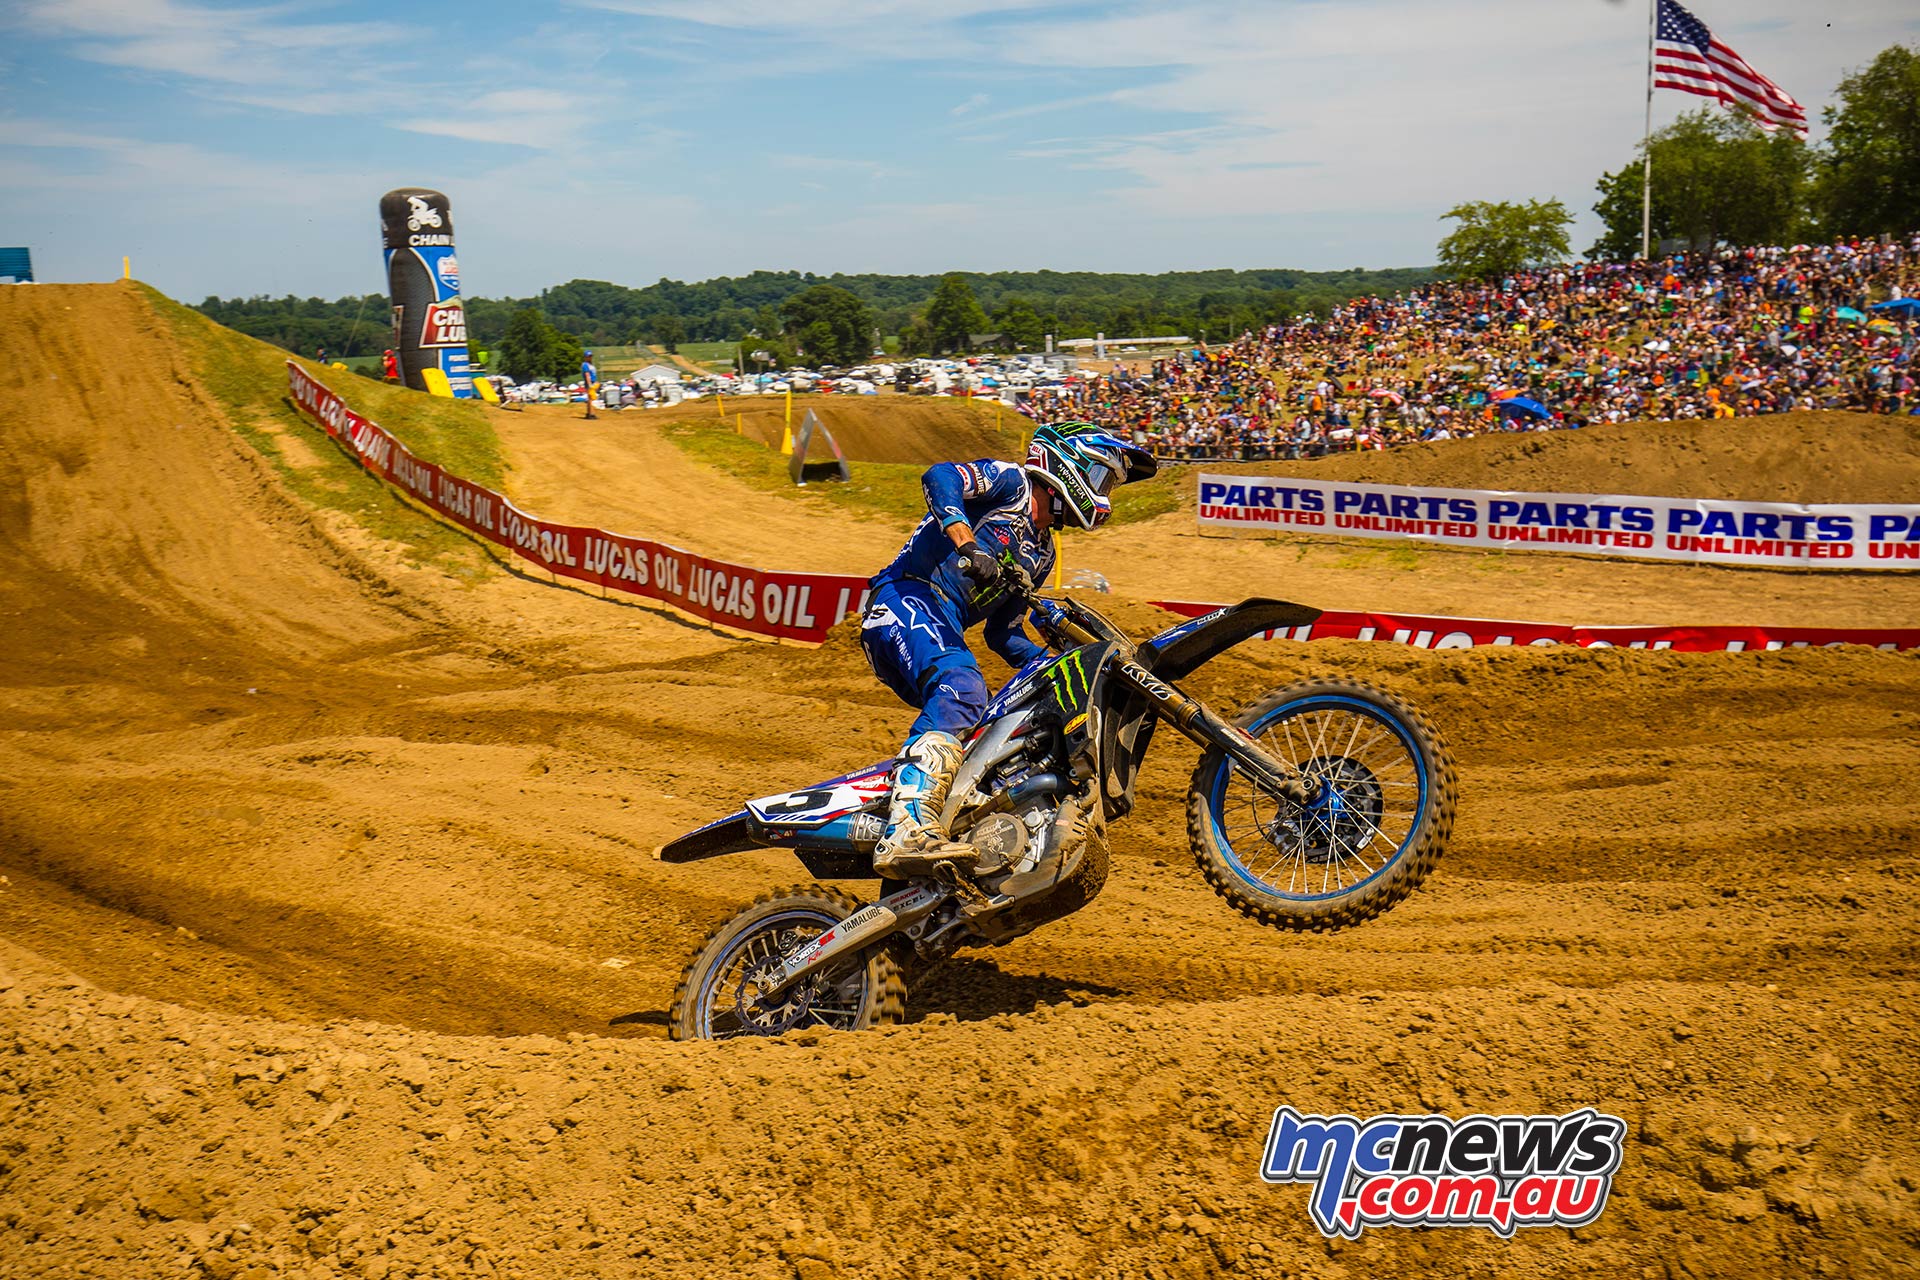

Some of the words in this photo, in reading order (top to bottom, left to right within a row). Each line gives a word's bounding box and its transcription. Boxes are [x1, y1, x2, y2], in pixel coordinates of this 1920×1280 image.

[1057, 463, 1086, 500] MONSTER
[438, 474, 472, 519] LUCAS
[474, 493, 493, 530] OIL
[1200, 482, 1324, 512] PARTS
[1334, 490, 1477, 522] PARTS
[1200, 504, 1325, 526] UNLIMITED
[1334, 513, 1477, 538] UNLIMITED
[1488, 500, 1654, 532] PARTS
[1668, 508, 1854, 541] PARTS
[540, 530, 576, 567] OIL
[1488, 524, 1653, 548] UNLIMITED
[1666, 534, 1853, 559] UNLIMITED
[584, 536, 649, 586] LUCAS
[654, 553, 684, 596] OIL
[687, 564, 756, 621] LUCAS
[762, 583, 816, 629] OIL
[1003, 681, 1034, 707] YAMALUBE
[1121, 662, 1176, 701] KYB
[845, 766, 878, 780] YAMAHA
[893, 894, 926, 911] EXCEL
[841, 906, 883, 933] YAMALUBE
[788, 941, 821, 968] VORTEX
